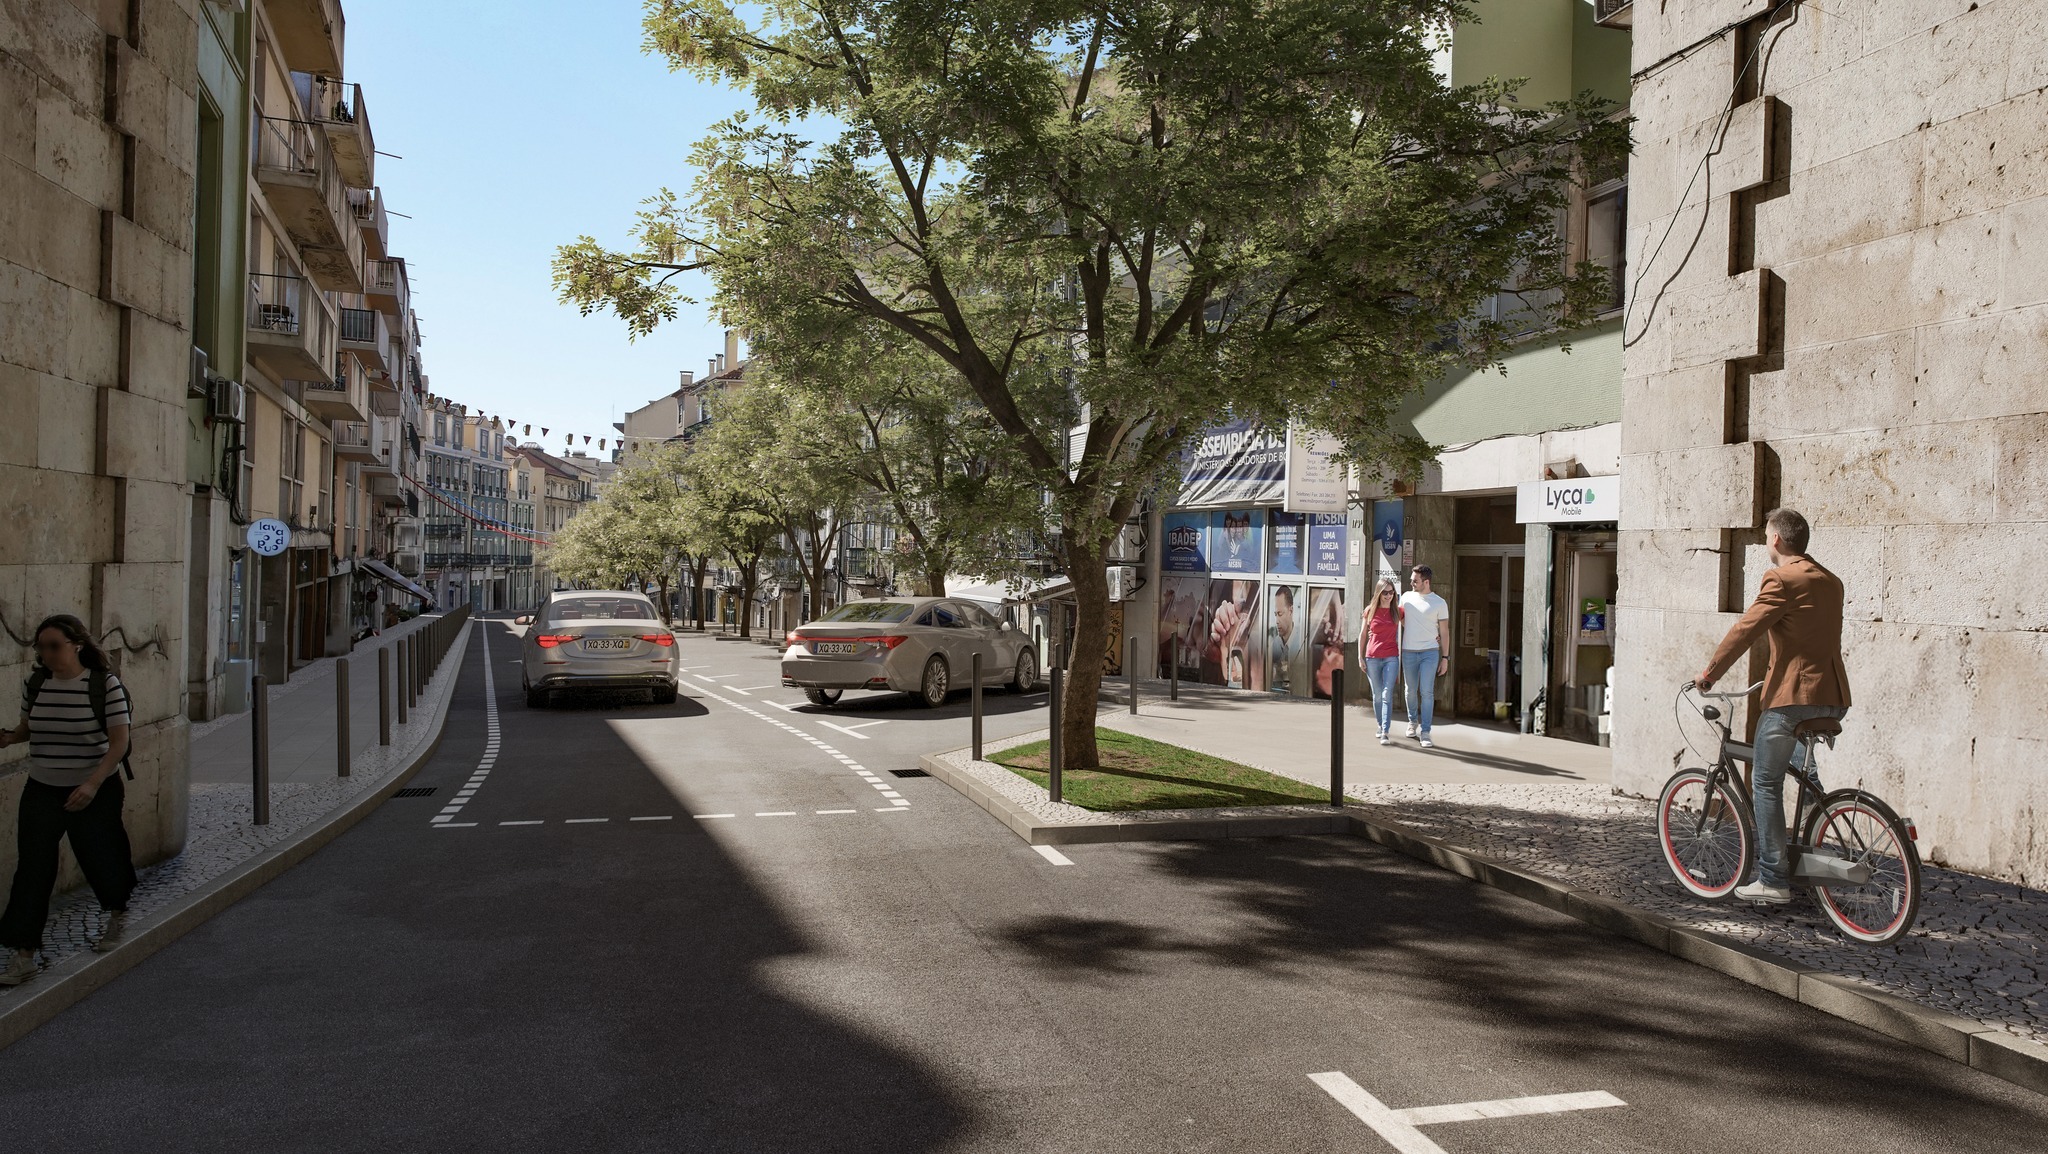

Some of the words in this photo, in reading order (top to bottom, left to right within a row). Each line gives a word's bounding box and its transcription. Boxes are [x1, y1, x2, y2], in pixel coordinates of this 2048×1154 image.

[1268, 452, 1278, 462] DE
[1546, 486, 1583, 510] Lyca
[1561, 507, 1582, 516] Mobile
[1315, 512, 1345, 524] MSBN
[1168, 532, 1202, 546] IBADEP
[1322, 531, 1336, 540] UMA
[1319, 541, 1339, 550] IGREJA
[1322, 552, 1335, 560] UMA
[1316, 560, 1340, 571] FAMÍLIA
